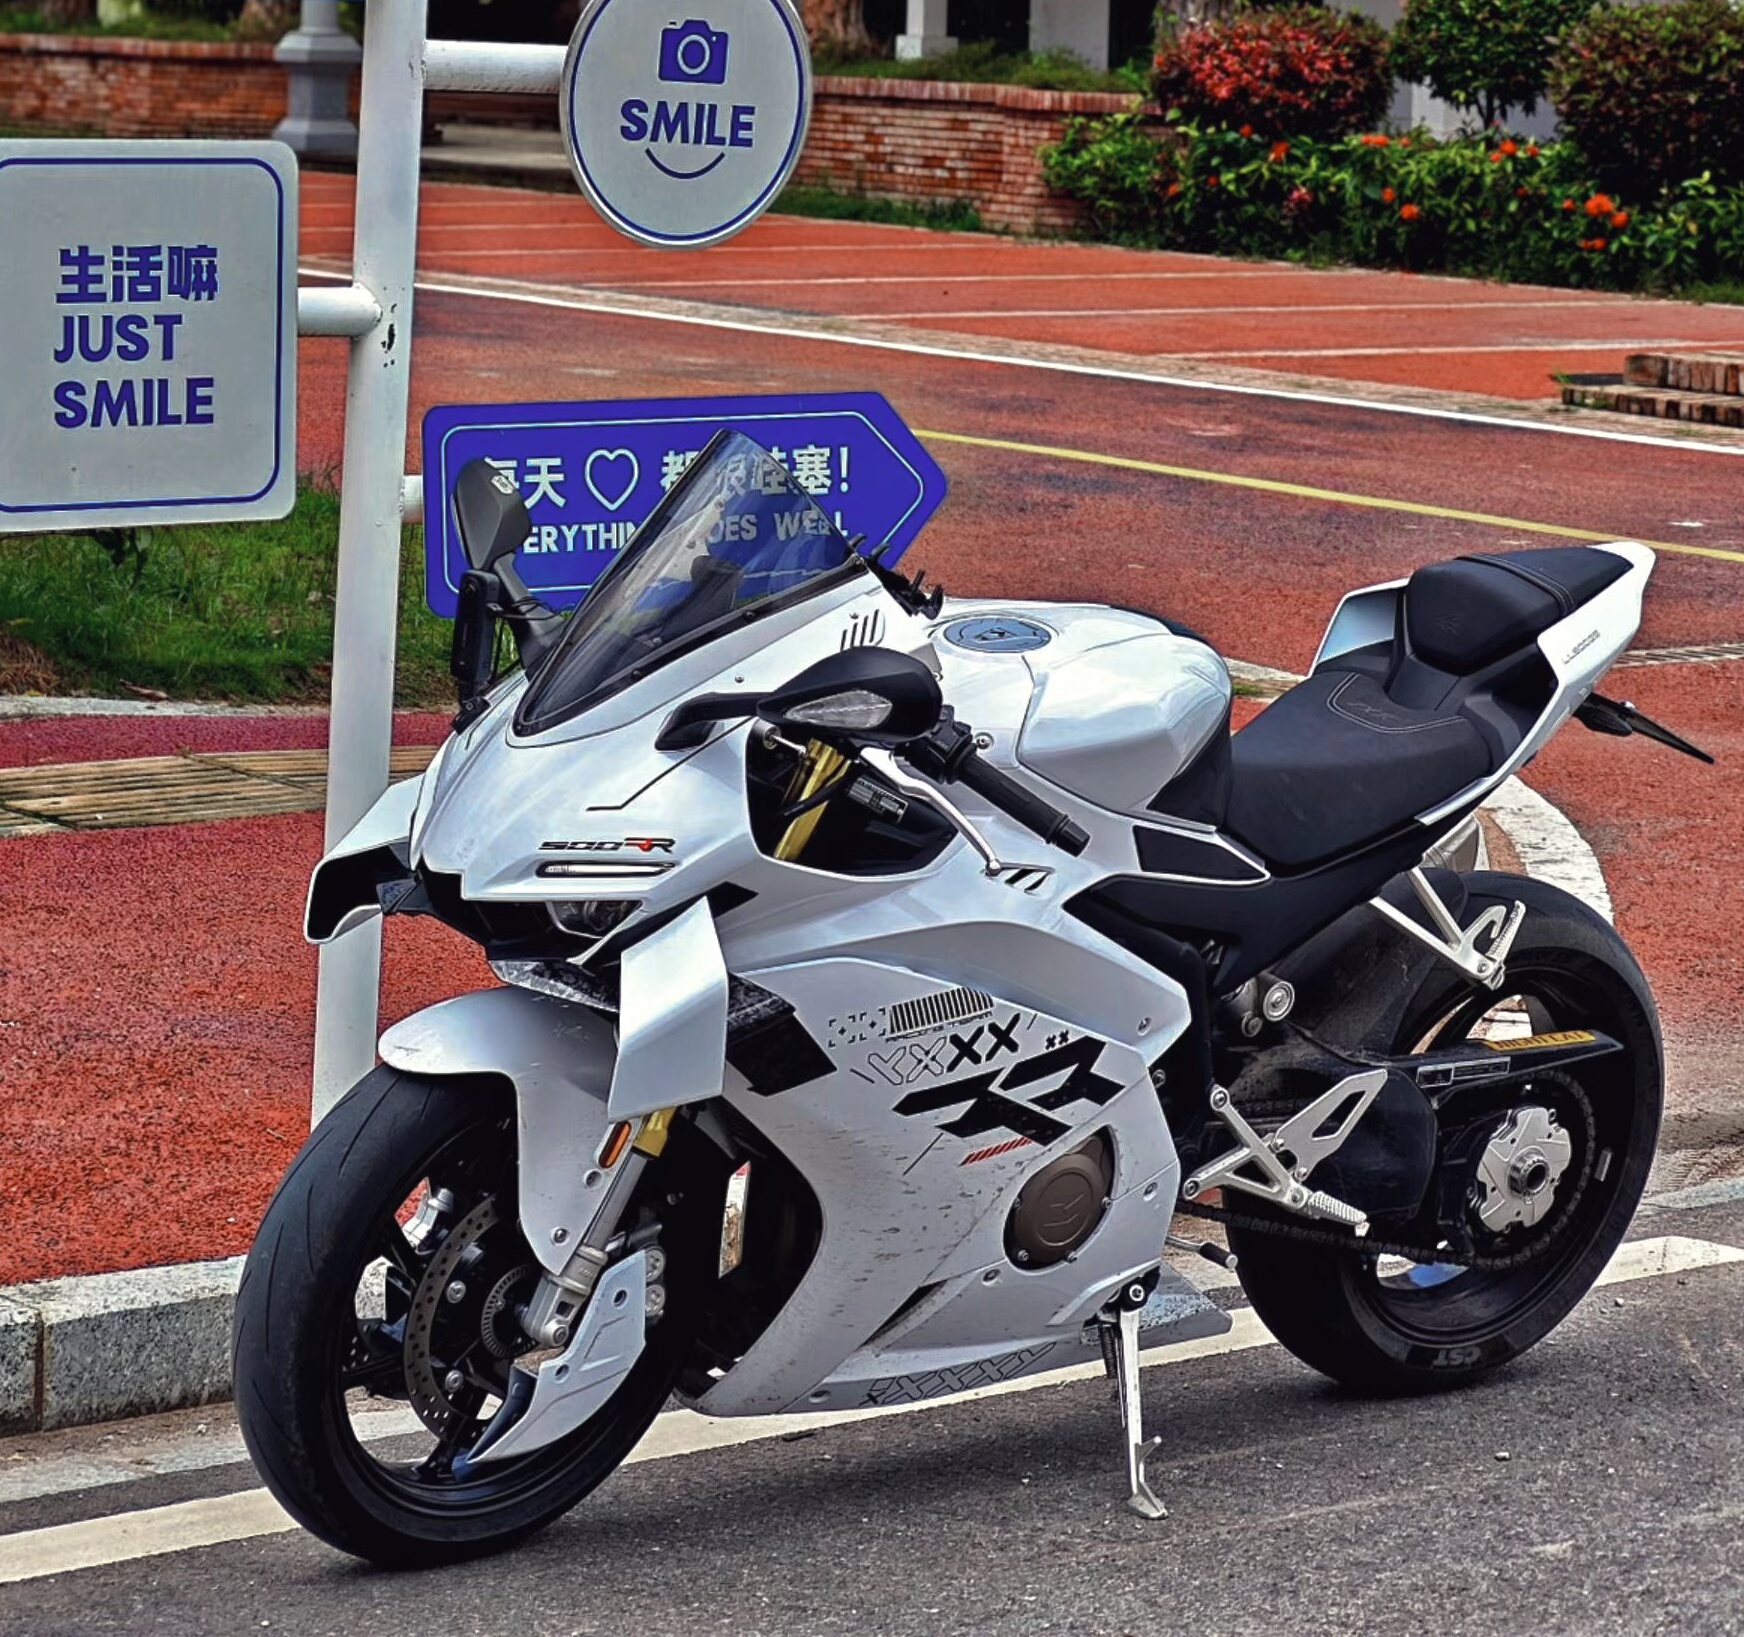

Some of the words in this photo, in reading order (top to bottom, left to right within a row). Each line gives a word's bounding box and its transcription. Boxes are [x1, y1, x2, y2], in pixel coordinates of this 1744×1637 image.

[620, 99, 755, 147] SMILE
[55, 244, 218, 303] 生活嘛
[54, 314, 182, 363] JUST
[54, 377, 214, 428] SMILE
[1433, 1346, 1480, 1366] CST
